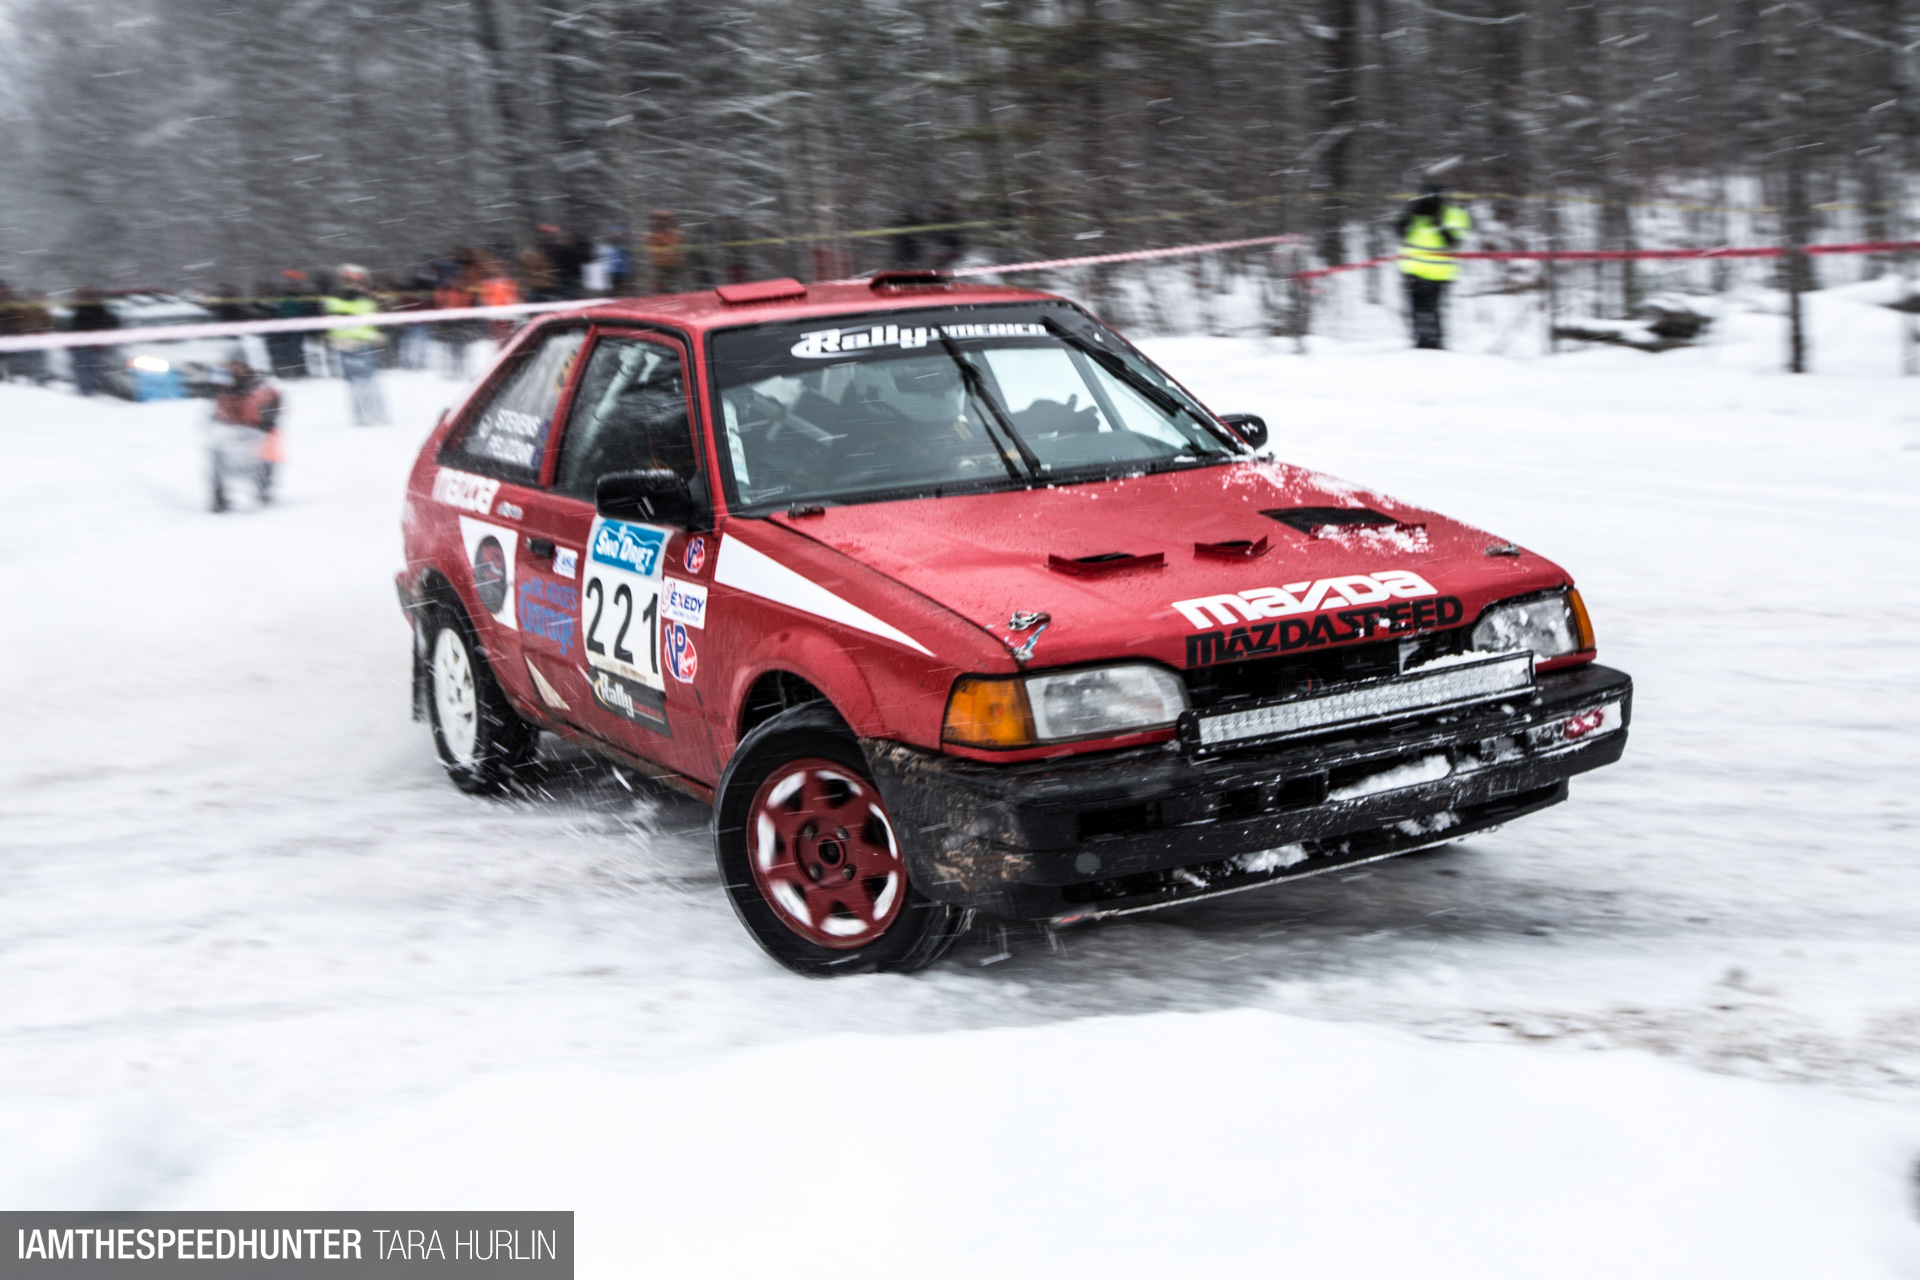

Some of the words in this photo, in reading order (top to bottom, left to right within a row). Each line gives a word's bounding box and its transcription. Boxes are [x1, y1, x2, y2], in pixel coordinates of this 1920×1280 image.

[799, 325, 928, 353] Rally
[586, 577, 659, 675] 221
[670, 591, 705, 614] EXEDY
[1186, 596, 1464, 669] MAZDASPEED
